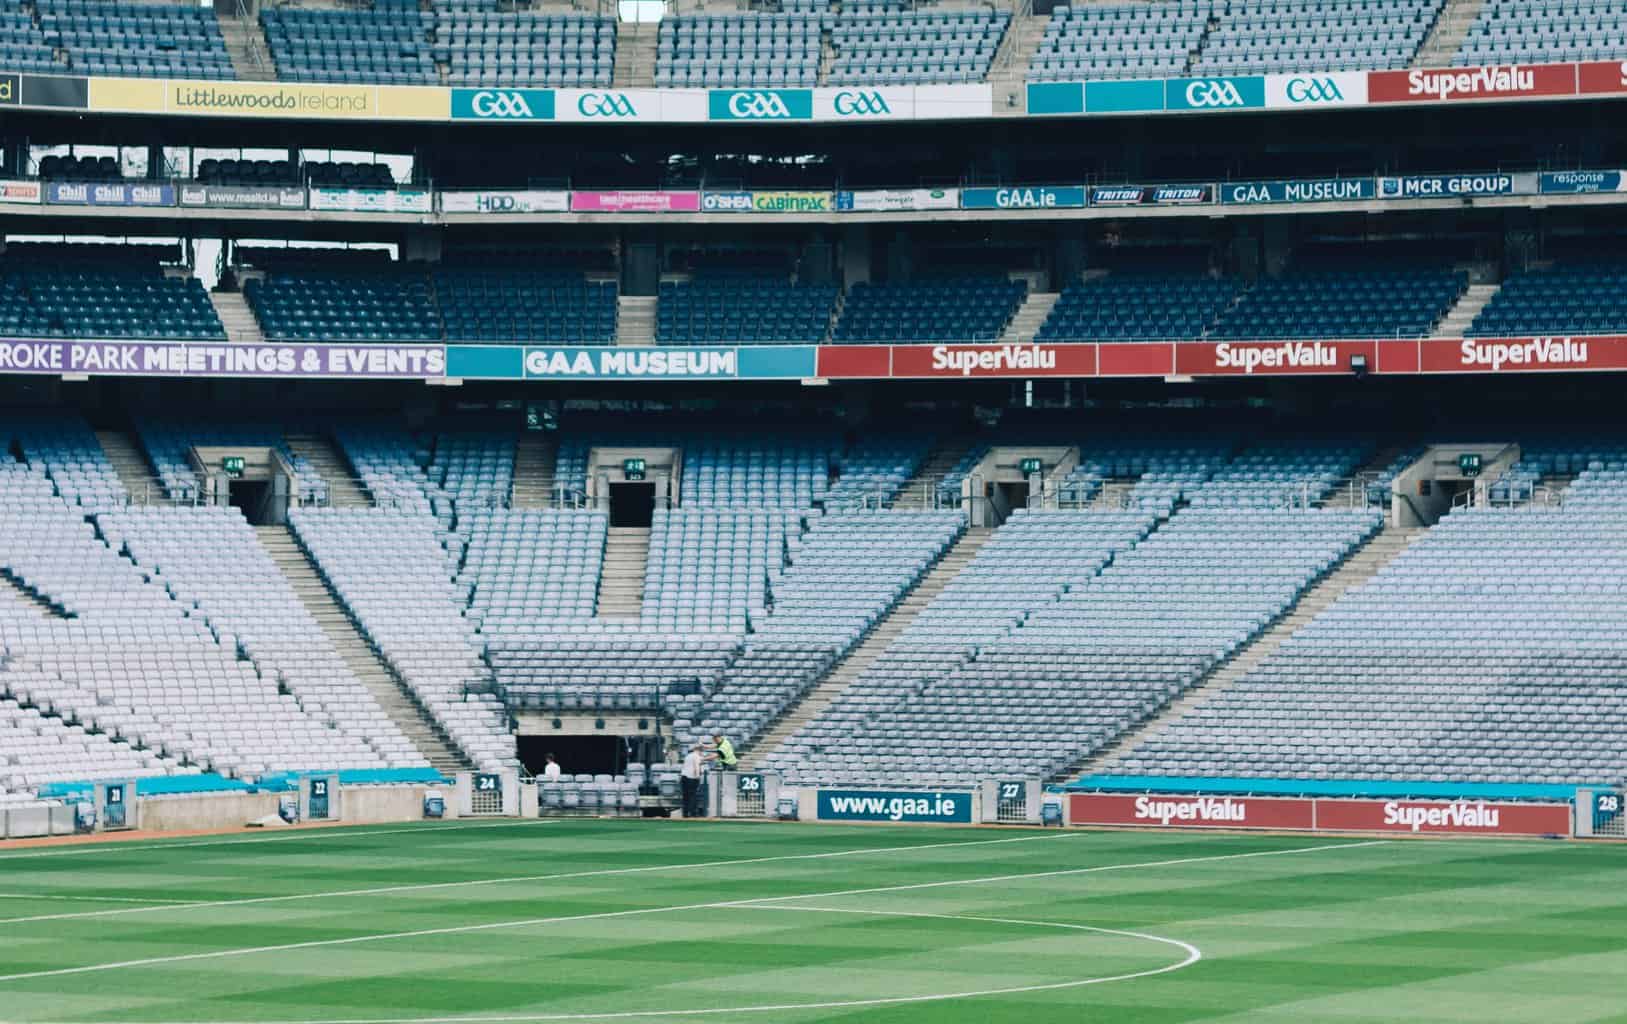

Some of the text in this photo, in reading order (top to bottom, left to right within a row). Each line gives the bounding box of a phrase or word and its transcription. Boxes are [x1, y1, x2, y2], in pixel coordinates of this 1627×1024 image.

[1185, 80, 1244, 107] GAA
[1286, 77, 1344, 102] GAA
[1409, 66, 1535, 98] SuperValu
[176, 87, 367, 111] Littlewoods Ireland
[472, 91, 533, 117] GAA
[577, 93, 637, 117] GAA
[728, 91, 790, 118] GAA
[834, 91, 891, 115] GAA
[1234, 182, 1362, 201] GAA MUSEUM
[1406, 179, 1442, 193] MCR
[1448, 176, 1509, 193] GROUP
[1553, 173, 1604, 186] response
[57, 185, 87, 201] Chill
[95, 186, 124, 202] Chill
[132, 187, 161, 202] Chill
[996, 189, 1056, 208] GAA.ie
[1097, 190, 1140, 200] TRITON
[1158, 189, 1202, 199] TRITON
[71, 344, 138, 370] PARK
[144, 347, 296, 372] MEETINGS
[301, 348, 321, 371] &
[329, 348, 444, 372] EVENTS
[526, 351, 735, 375] GAA MUSEUM
[932, 345, 1056, 375] SuperValu
[1215, 343, 1337, 373] SuperValu
[1460, 338, 1588, 369] SuperValu
[480, 777, 495, 789] 24
[741, 777, 759, 790] 26
[1002, 783, 1018, 798] 27
[830, 794, 955, 820] www.gaa.ie
[1134, 797, 1245, 824] SuperValu
[1599, 795, 1618, 811] 28
[1384, 802, 1499, 831] SuperValu
